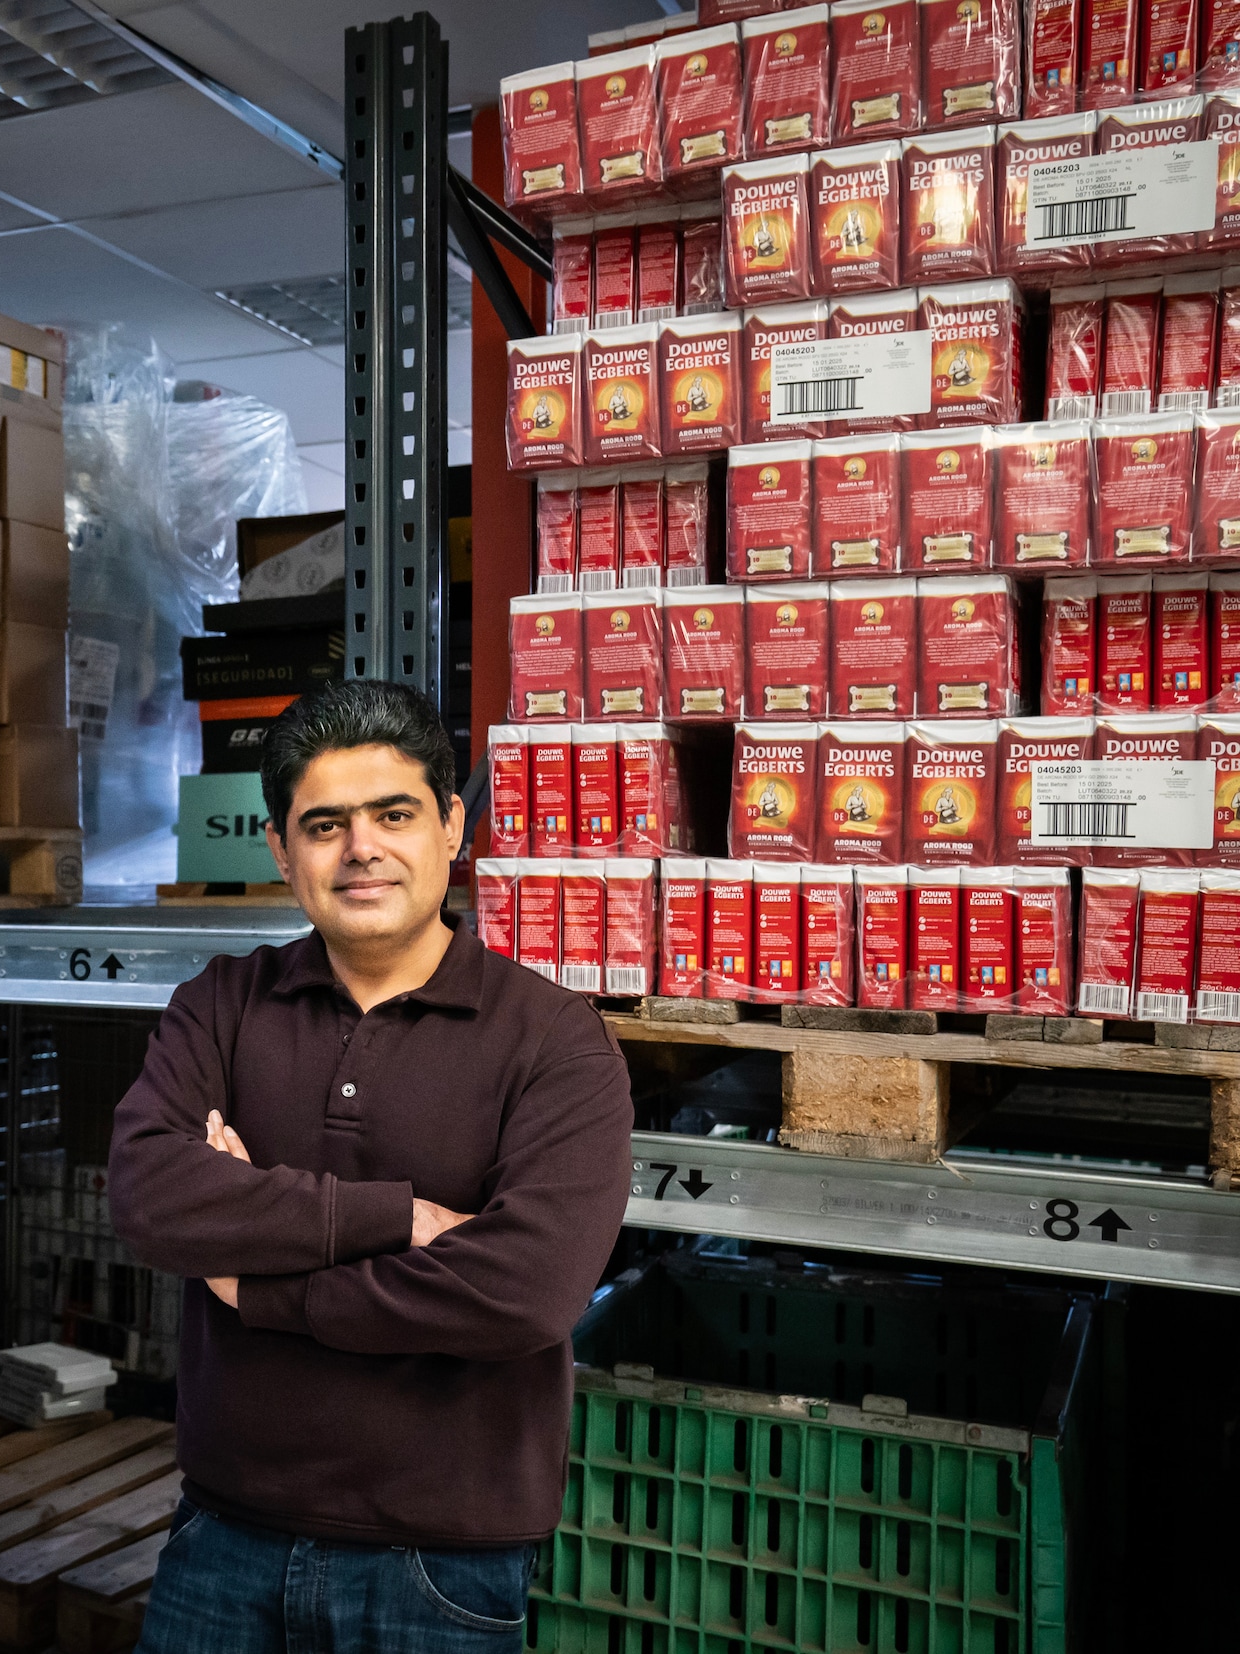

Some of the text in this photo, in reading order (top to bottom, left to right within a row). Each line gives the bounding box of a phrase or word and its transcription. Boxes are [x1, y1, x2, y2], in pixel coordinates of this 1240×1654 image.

[1034, 164, 1080, 176] 04045203
[910, 168, 984, 191] EGBERTS
[818, 183, 890, 205] EGBERTS
[731, 194, 800, 216] EGBERTS
[922, 250, 972, 262] AROMA ROOD
[831, 262, 880, 274] AROMA ROOD
[744, 271, 790, 284] AROMA ROOD
[776, 346, 816, 356] 04045203
[666, 352, 730, 372] EGBERTS
[589, 362, 650, 380] EGBERTS
[514, 372, 573, 390] EGBERTS
[937, 403, 987, 414] AROMA ROOD
[679, 426, 722, 437] AROMA ROOD
[601, 434, 642, 444] AROMA ROOD
[524, 444, 547, 452] AROMA
[1108, 606, 1142, 614] EGBERTS
[1162, 603, 1199, 612] EGBERTS
[536, 754, 564, 762] EGBERTS
[580, 754, 608, 762] EGBERTS
[738, 760, 805, 774] EGBERTS
[824, 763, 894, 778] EGBERTS
[912, 764, 986, 779] EGBERTS
[1038, 766, 1082, 774] 04045203
[747, 834, 772, 842] AROMA
[924, 842, 950, 850] AROMA
[866, 896, 898, 904] EGBERTS
[918, 897, 952, 905] EGBERTS
[970, 898, 1004, 906] EGBERTS
[70, 948, 91, 981] 6
[649, 1163, 678, 1200] 7
[1043, 1198, 1080, 1242] 8
